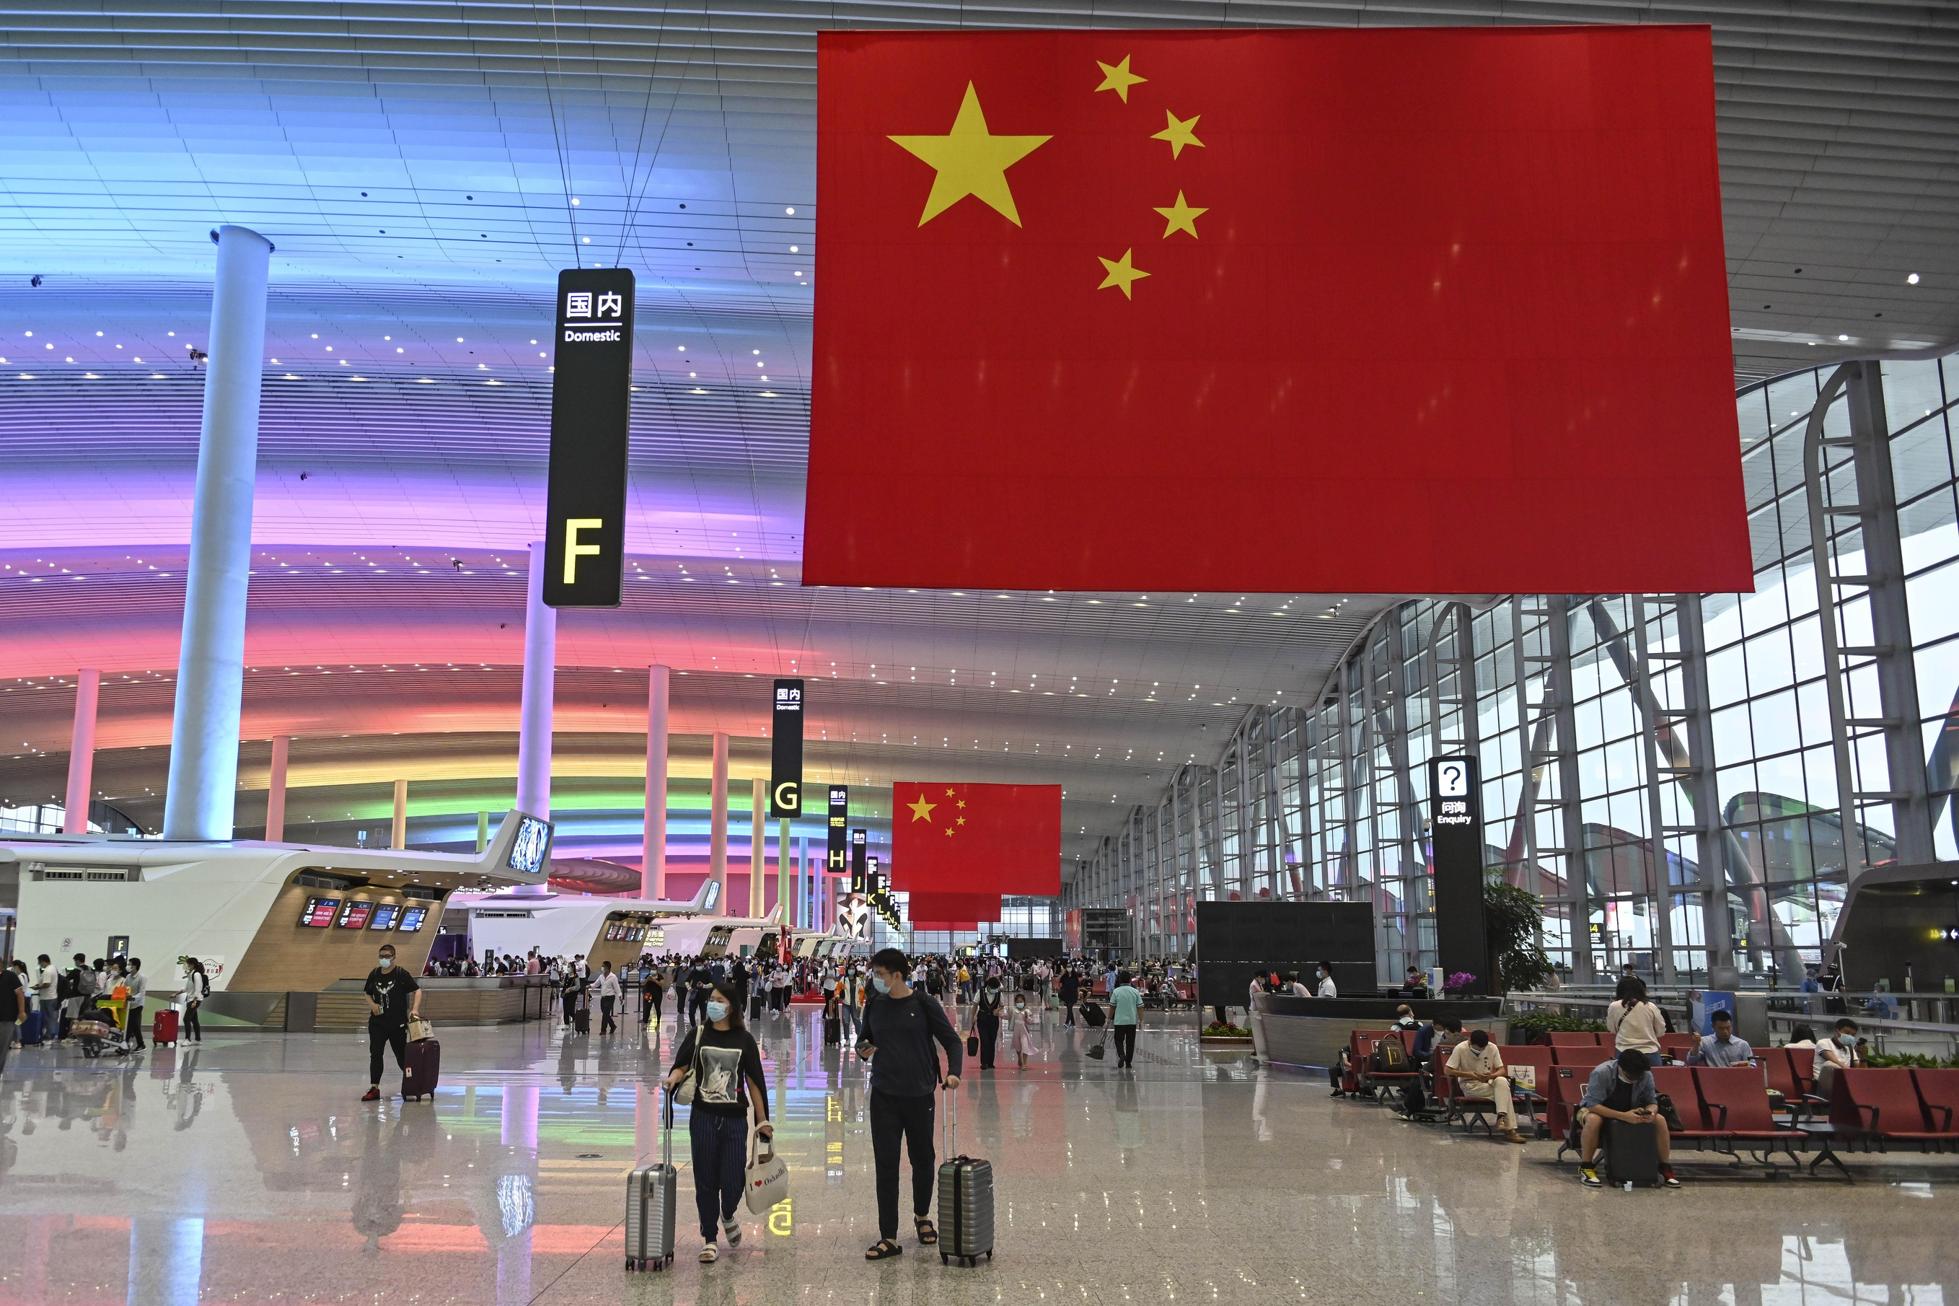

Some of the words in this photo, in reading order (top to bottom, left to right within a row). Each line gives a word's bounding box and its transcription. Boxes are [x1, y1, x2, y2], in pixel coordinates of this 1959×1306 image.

[567, 291, 622, 318] 国内
[565, 330, 621, 342] Domestic
[564, 518, 602, 584] F
[777, 688, 800, 700] 国内
[775, 781, 798, 810] G
[1438, 815, 1471, 824] Enquiry
[829, 849, 844, 868] H
[854, 876, 861, 890] J
[868, 894, 876, 904] K
[879, 905, 884, 913] L
[118, 940, 124, 951] F
